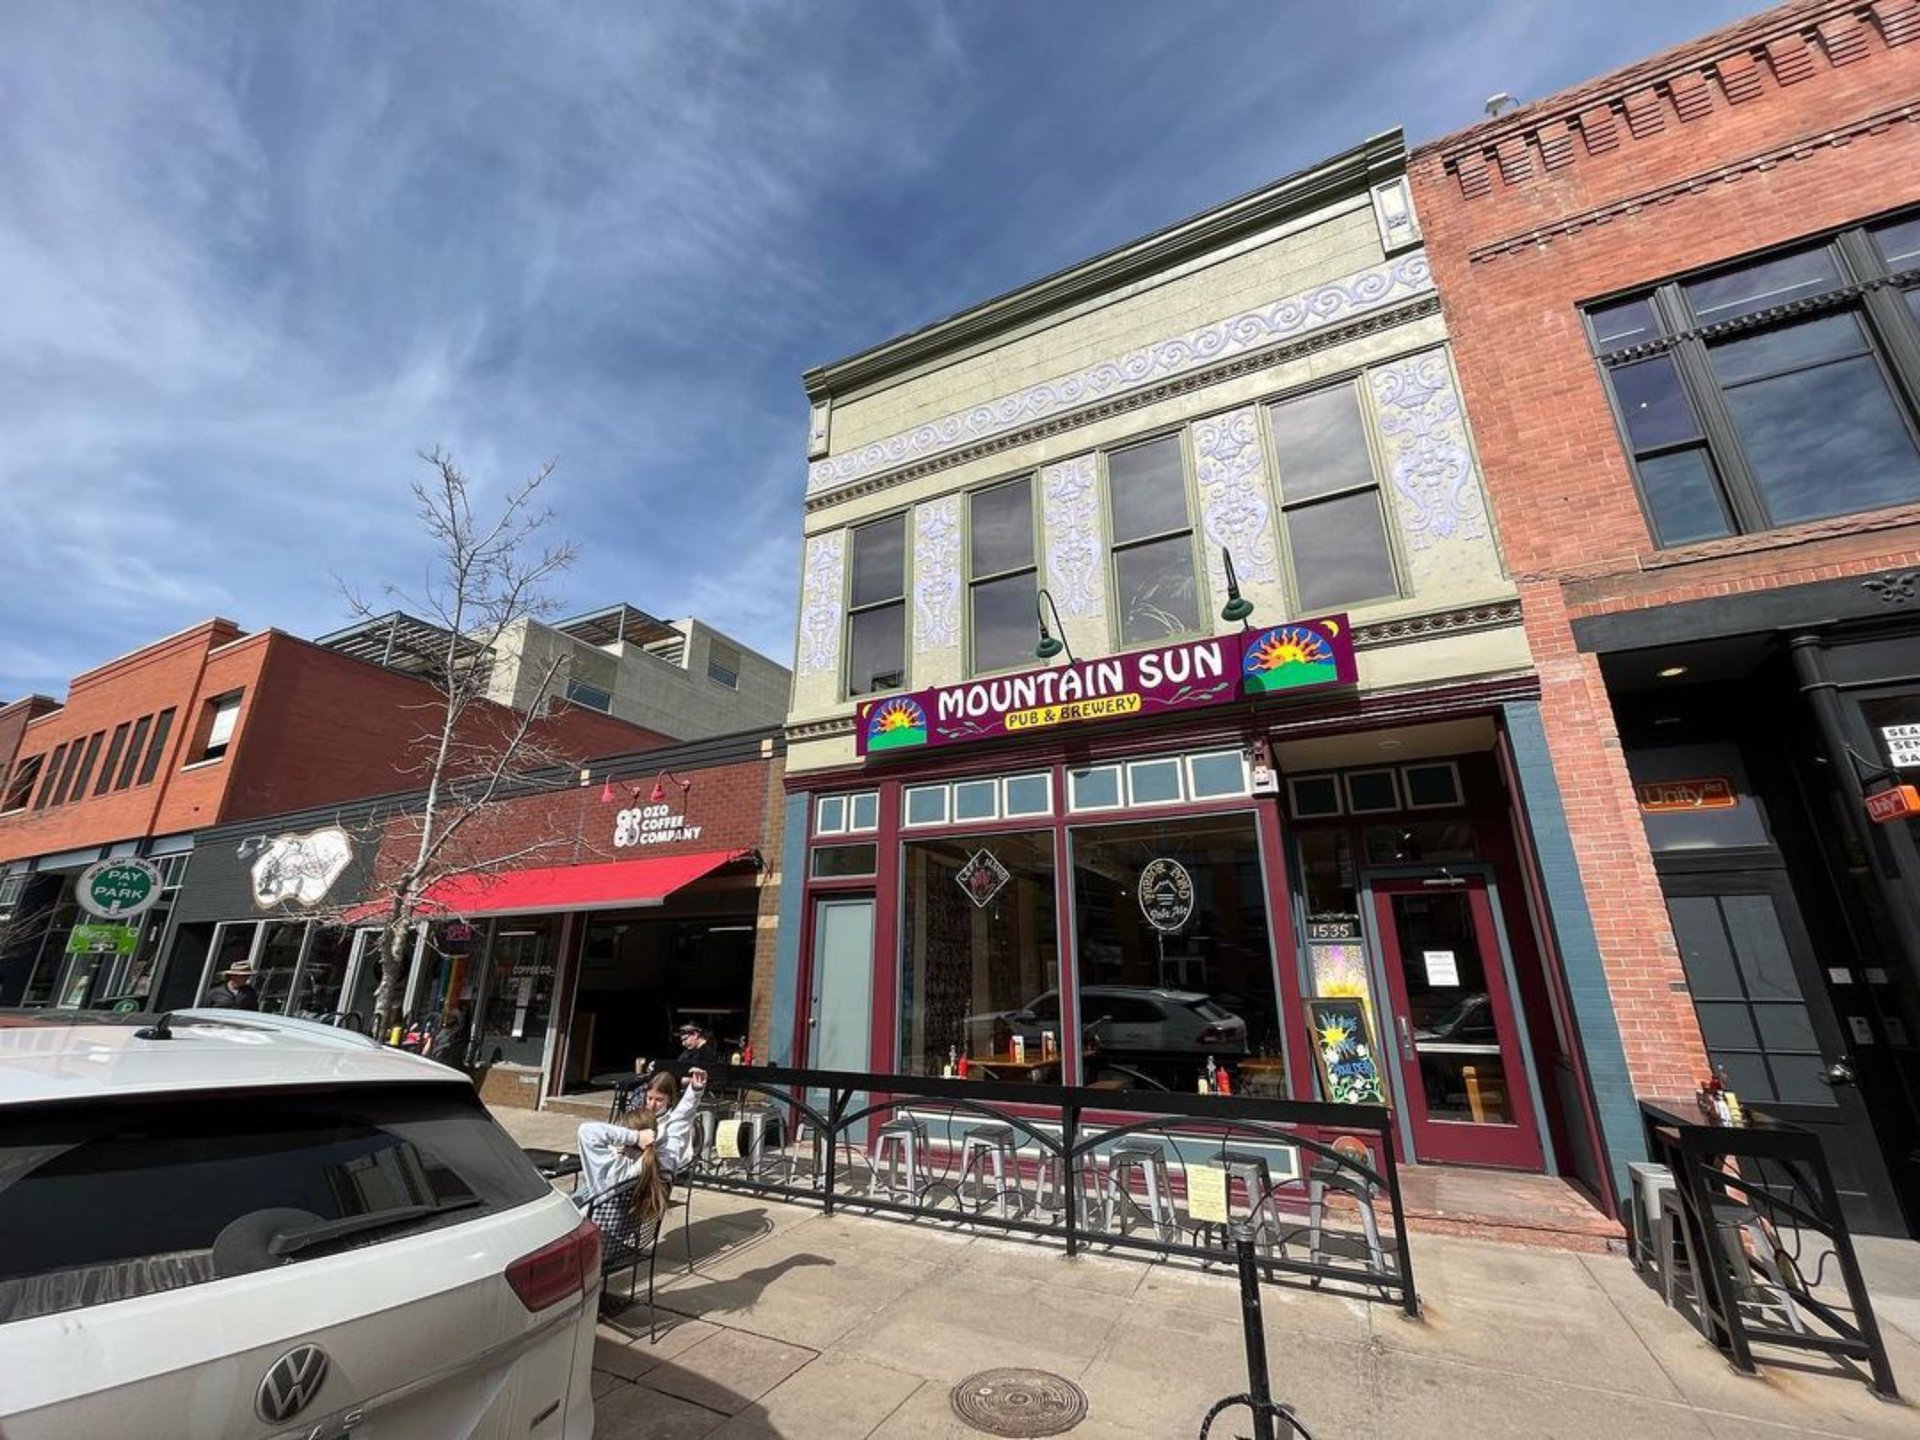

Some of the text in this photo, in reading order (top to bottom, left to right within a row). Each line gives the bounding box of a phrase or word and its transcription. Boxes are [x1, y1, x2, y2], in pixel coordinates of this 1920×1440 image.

[938, 642, 1223, 721] MOUNTAIN SUN
[1008, 696, 1137, 728] PUB & BREWERY
[1645, 785, 1703, 807] Unity
[643, 804, 669, 818] OZO
[641, 815, 685, 831] COFFEE
[640, 826, 702, 845] COMPANY
[108, 870, 142, 881] PAY
[94, 886, 143, 899] PARK
[1313, 923, 1349, 938] 1535
